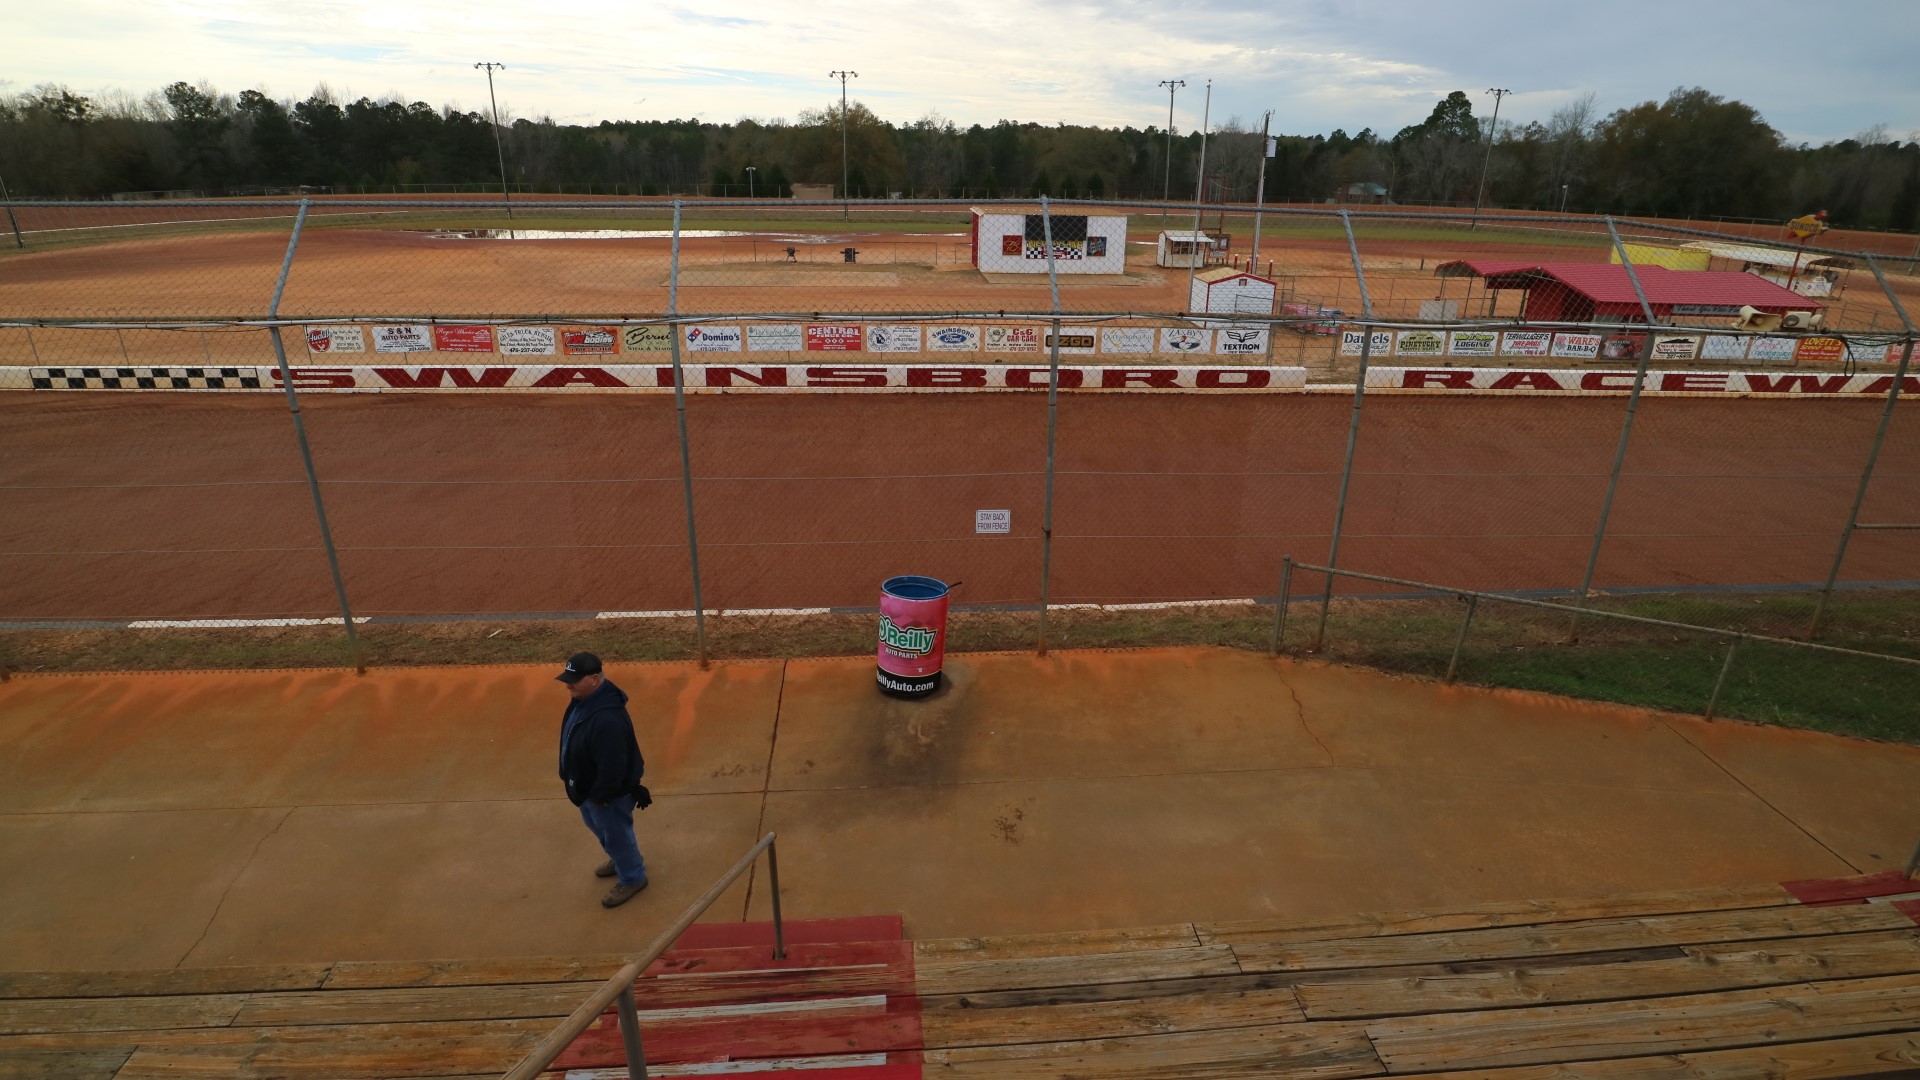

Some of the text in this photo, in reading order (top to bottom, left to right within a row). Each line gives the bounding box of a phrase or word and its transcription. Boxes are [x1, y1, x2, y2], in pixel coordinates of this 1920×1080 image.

[1791, 221, 1819, 233] SUNOCO
[808, 326, 860, 336] CENTRAL
[932, 328, 975, 339] SWAINSBORO
[702, 332, 740, 341] Domino's
[944, 335, 963, 343] Ford
[1344, 333, 1389, 344] Daels
[1568, 336, 1601, 346] WARE'S
[1400, 340, 1441, 349] PINETUCKY
[1567, 345, 1597, 353] BAR-B-Q
[270, 367, 1920, 394] SWAINSBORO RACEWA
[980, 513, 1006, 521] STAY BACK
[978, 522, 1008, 530] FROM FENCE
[885, 648, 918, 659] AUTO PARTS
